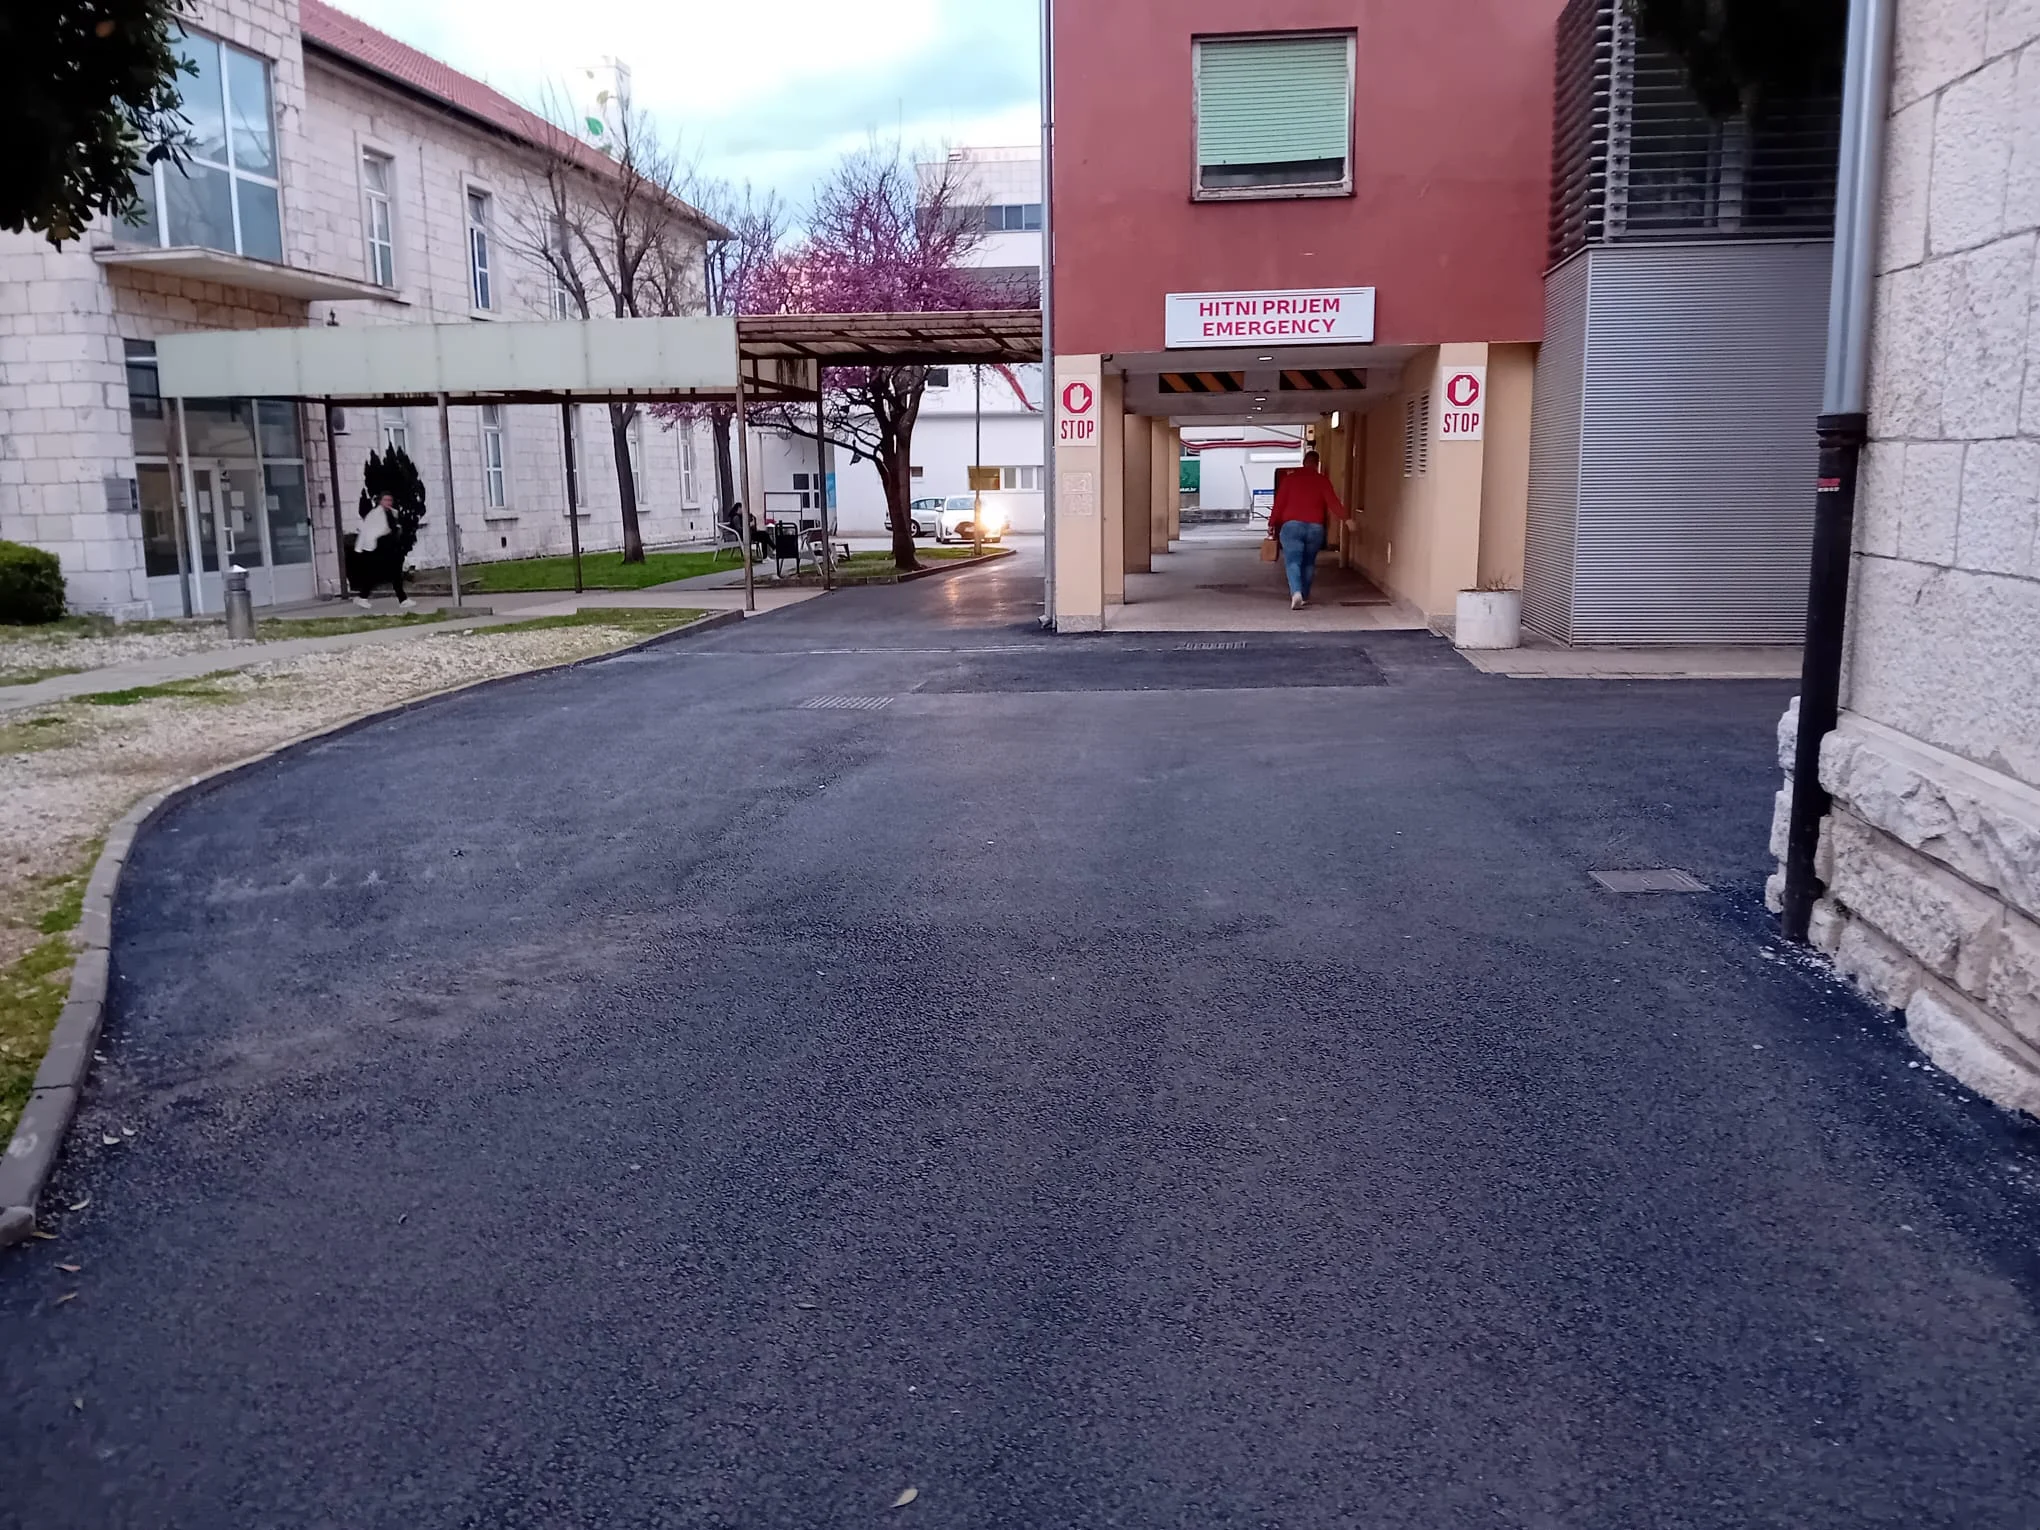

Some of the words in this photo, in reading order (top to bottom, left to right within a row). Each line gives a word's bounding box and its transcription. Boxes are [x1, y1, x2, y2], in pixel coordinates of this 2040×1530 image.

[1199, 301, 1256, 317] HITNI
[1263, 298, 1340, 315] PRIJEM
[1203, 318, 1336, 337] EMERGENCY
[1061, 419, 1094, 439] STOP
[1443, 412, 1480, 433] STOP
